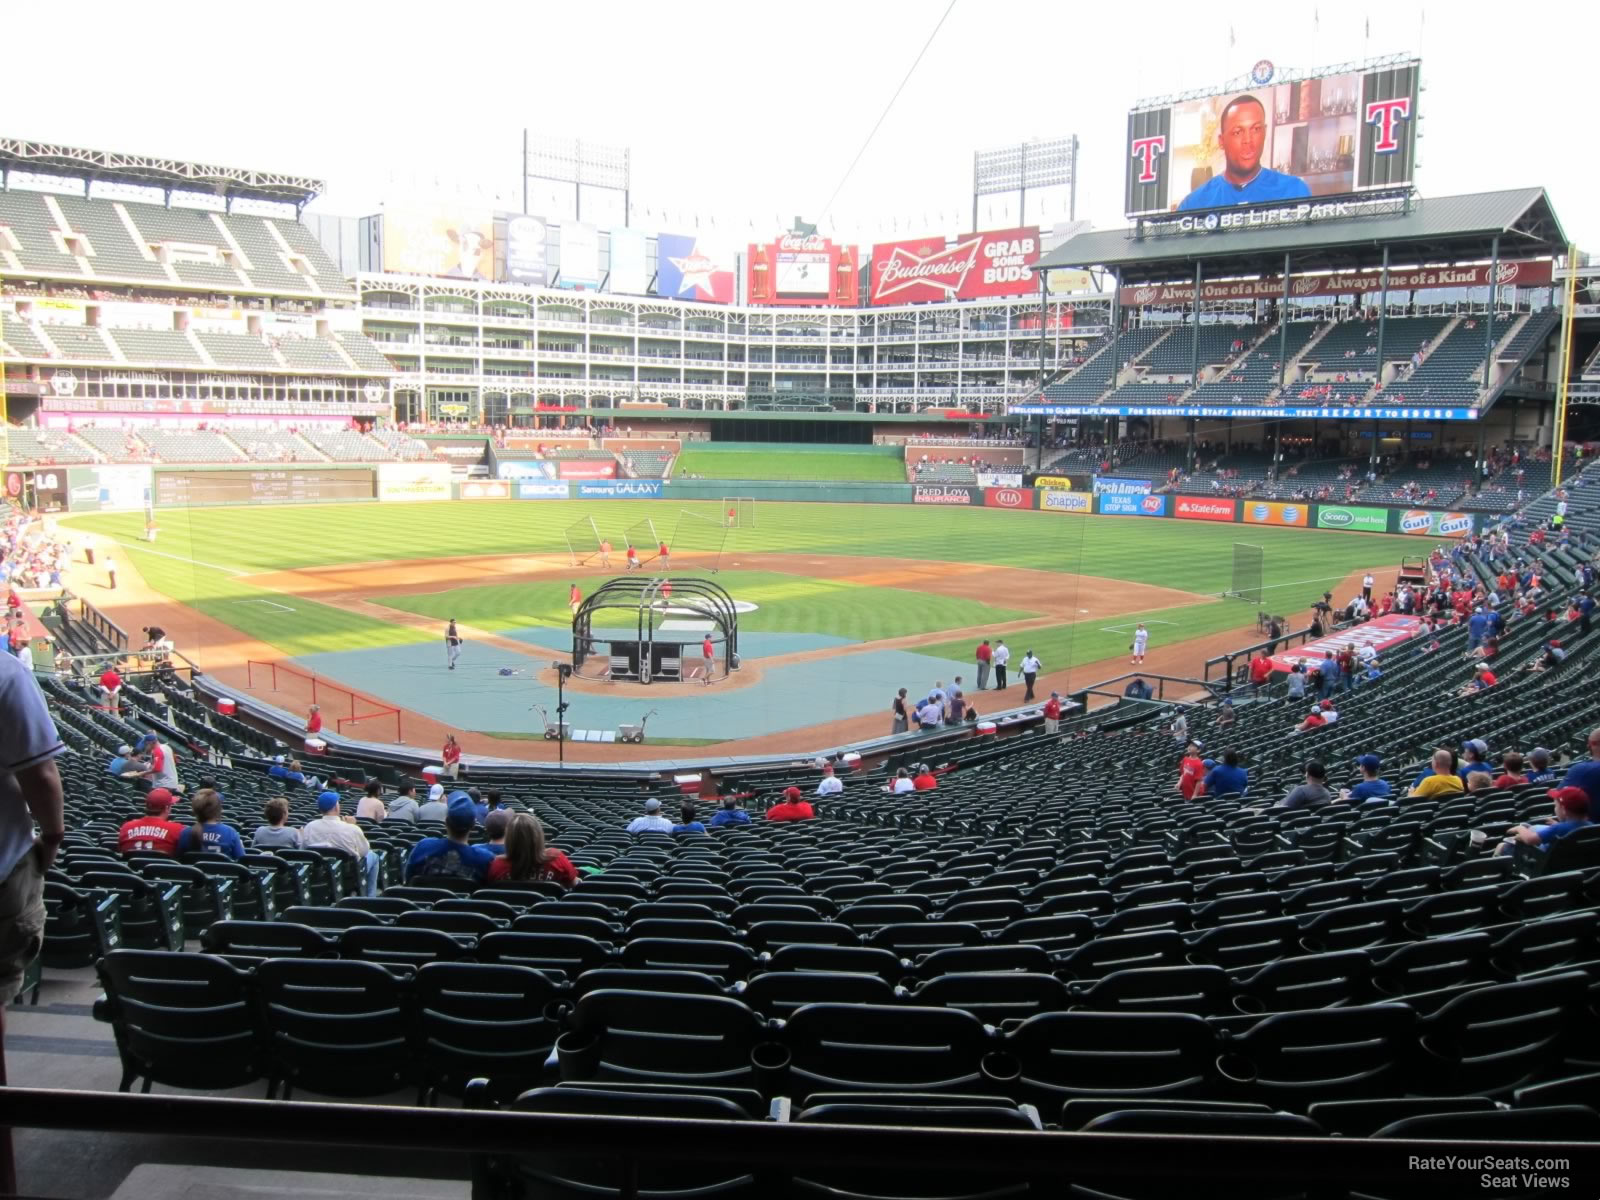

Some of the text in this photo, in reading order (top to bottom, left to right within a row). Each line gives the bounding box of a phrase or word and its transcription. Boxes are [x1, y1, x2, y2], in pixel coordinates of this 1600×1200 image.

[1366, 97, 1410, 153] T
[1132, 135, 1166, 183] T
[1179, 203, 1348, 231] GLOBE LIFE PARK
[984, 239, 1034, 258] GRAB
[877, 256, 976, 282] Budweiser
[993, 255, 1025, 268] SOME
[984, 266, 1033, 284] BUDS
[1326, 276, 1377, 292] Always
[1410, 272, 1427, 284] of
[1428, 275, 1436, 284] a
[1438, 269, 1476, 283] Kind
[1161, 281, 1284, 300] Alway One of a Kind
[1082, 407, 1099, 415] LIFE
[1101, 407, 1121, 415] PARK
[1128, 407, 1144, 415] FOR
[1147, 407, 1185, 415] SECURITY
[1202, 408, 1228, 416] STAFF
[36, 474, 58, 489] LG
[581, 483, 659, 495] Samsung GALAXY
[1039, 478, 1066, 487] Chicken
[1094, 481, 1118, 494] Cash
[916, 486, 970, 497] FRED LOYA
[1000, 493, 1018, 503] KIA
[1046, 493, 1087, 510] Snapple
[1111, 496, 1131, 504] TEXAS
[1143, 499, 1158, 509] DQ
[1323, 511, 1350, 522] Scotts
[1355, 516, 1370, 524] used
[1402, 516, 1431, 531] Gulf
[1440, 518, 1469, 533] Gulf
[127, 825, 168, 840] DARVISH
[203, 832, 221, 842] RUZ
